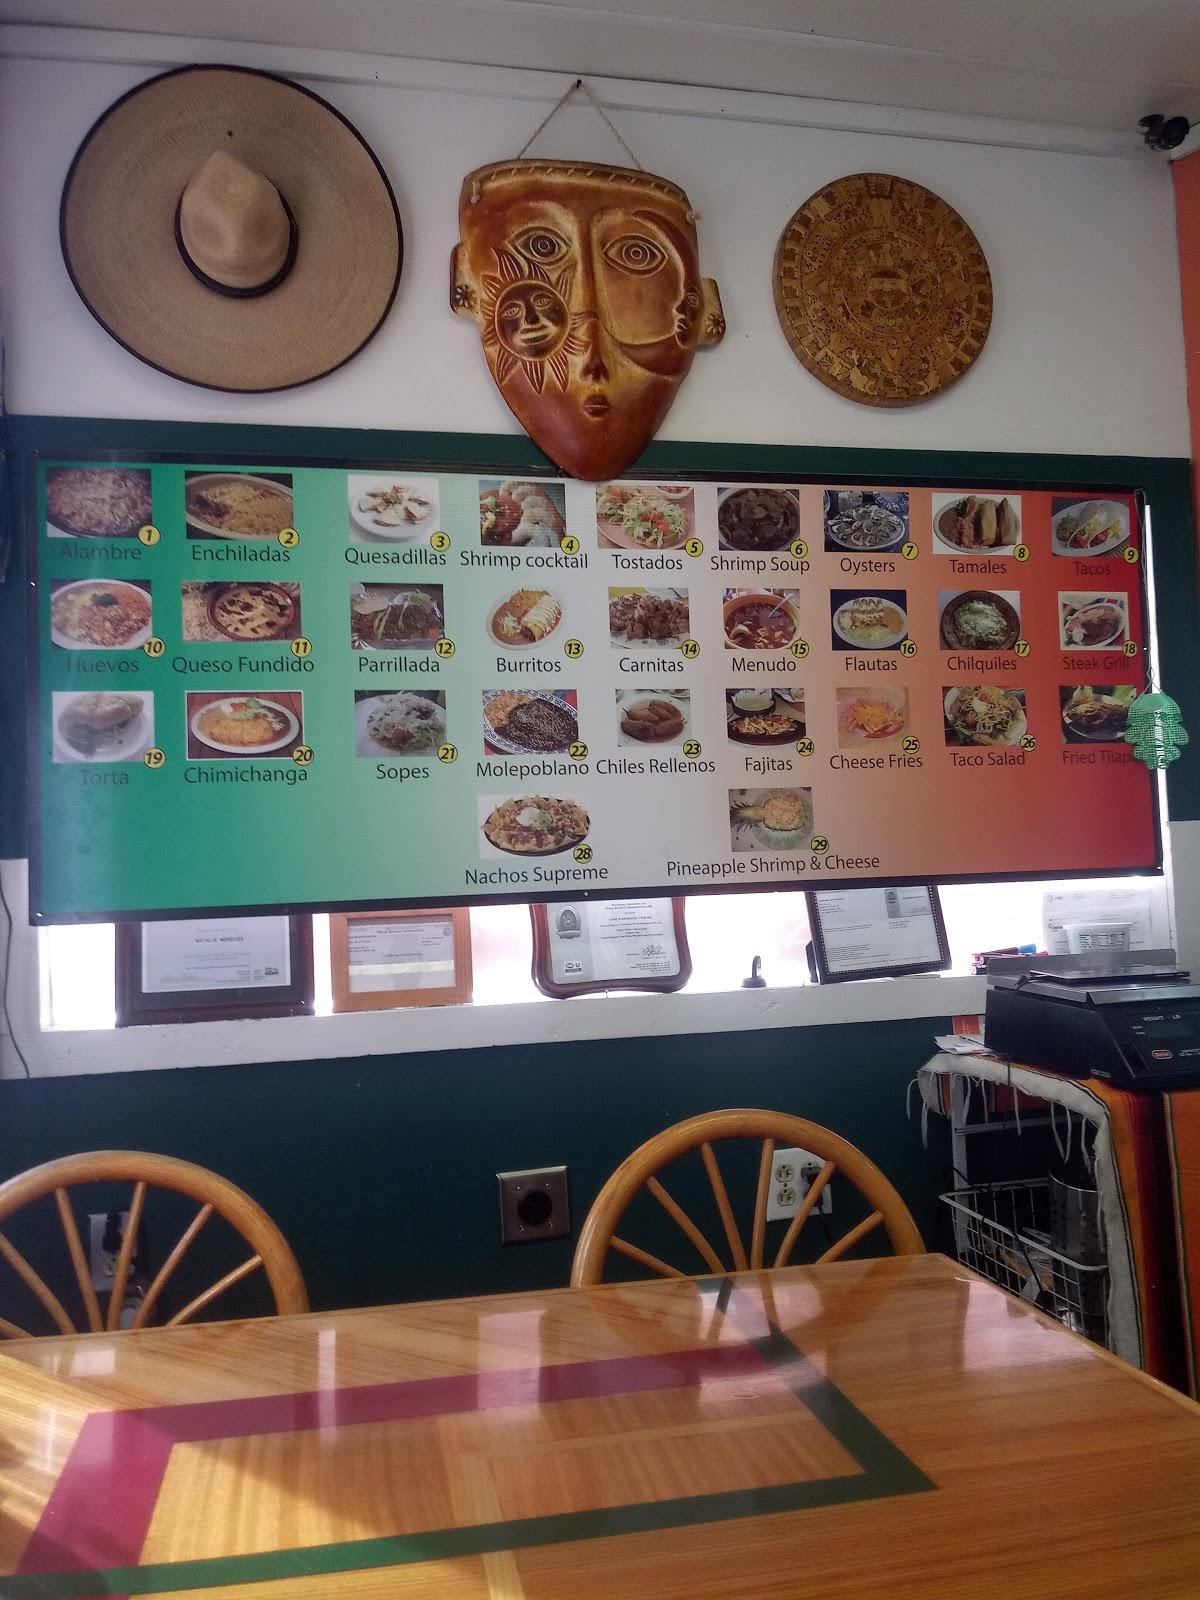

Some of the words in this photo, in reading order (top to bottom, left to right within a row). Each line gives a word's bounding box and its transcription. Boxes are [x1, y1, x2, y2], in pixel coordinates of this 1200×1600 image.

[146, 530, 153, 541] 1
[285, 533, 293, 544] 2
[437, 536, 444, 547] 3
[60, 542, 142, 560] Alambre
[565, 540, 574, 551] 4
[691, 542, 698, 553] 5
[796, 544, 803, 555] 6
[906, 546, 914, 556] 7
[192, 545, 290, 562] Enchiladas
[345, 548, 447, 565] Quesadillas
[1017, 547, 1025, 558] 8
[1127, 550, 1135, 560] 9
[460, 551, 521, 570] Shrimp
[526, 553, 588, 568] cocktail
[612, 554, 683, 570] Tostados
[710, 556, 766, 574] Shrimp
[771, 556, 810, 574] Soup
[840, 558, 895, 575] Oysters
[949, 559, 1007, 574] Tamales
[1073, 562, 1112, 575] Tacos
[146, 642, 162, 653] 10
[294, 642, 308, 653] 11
[438, 643, 451, 653] 12
[568, 643, 580, 654] 13
[684, 643, 697, 654] 14
[794, 643, 806, 654] 15
[902, 643, 915, 654] 16
[1016, 643, 1027, 654] 17
[1124, 643, 1135, 654] 18
[67, 657, 139, 673] Huevos
[172, 656, 232, 673] Queso
[239, 656, 314, 673] Fundido
[358, 656, 440, 672] Parrillada
[497, 657, 561, 672] Burritos
[619, 657, 684, 672] Carnitas
[732, 657, 796, 672] Menudo
[845, 656, 897, 671] Flautas
[947, 656, 1017, 673] Chilquiles
[1063, 656, 1098, 670] Steak
[1104, 656, 1129, 669] Grill
[685, 743, 700, 754] 23
[798, 742, 813, 752] 24
[904, 739, 918, 750] 25
[1022, 738, 1035, 748] 26
[296, 750, 312, 761] 20
[441, 748, 455, 759] 21
[572, 746, 587, 756] 22
[1062, 750, 1095, 764] Fried
[1099, 750, 1131, 765] Tilap
[147, 753, 163, 765] 19
[746, 756, 792, 775] Fajitas
[830, 754, 884, 769] Cheese
[889, 753, 923, 768] Fries
[950, 752, 983, 767] Taco
[987, 751, 1026, 766] Salad
[376, 763, 430, 782] Sopes
[476, 760, 589, 780] Molepoblano
[596, 759, 645, 775] Chiles
[650, 757, 716, 773] Rellenos
[81, 769, 129, 785] Torta
[184, 766, 308, 785] Chimichanga
[812, 839, 827, 850] 29
[575, 849, 591, 860] 28
[667, 858, 746, 878] Pineapple
[750, 856, 806, 874] Shrimp
[810, 856, 821, 870] &
[825, 855, 880, 870] Cheese
[465, 867, 528, 885] Nachos
[533, 865, 608, 883] Supreme
